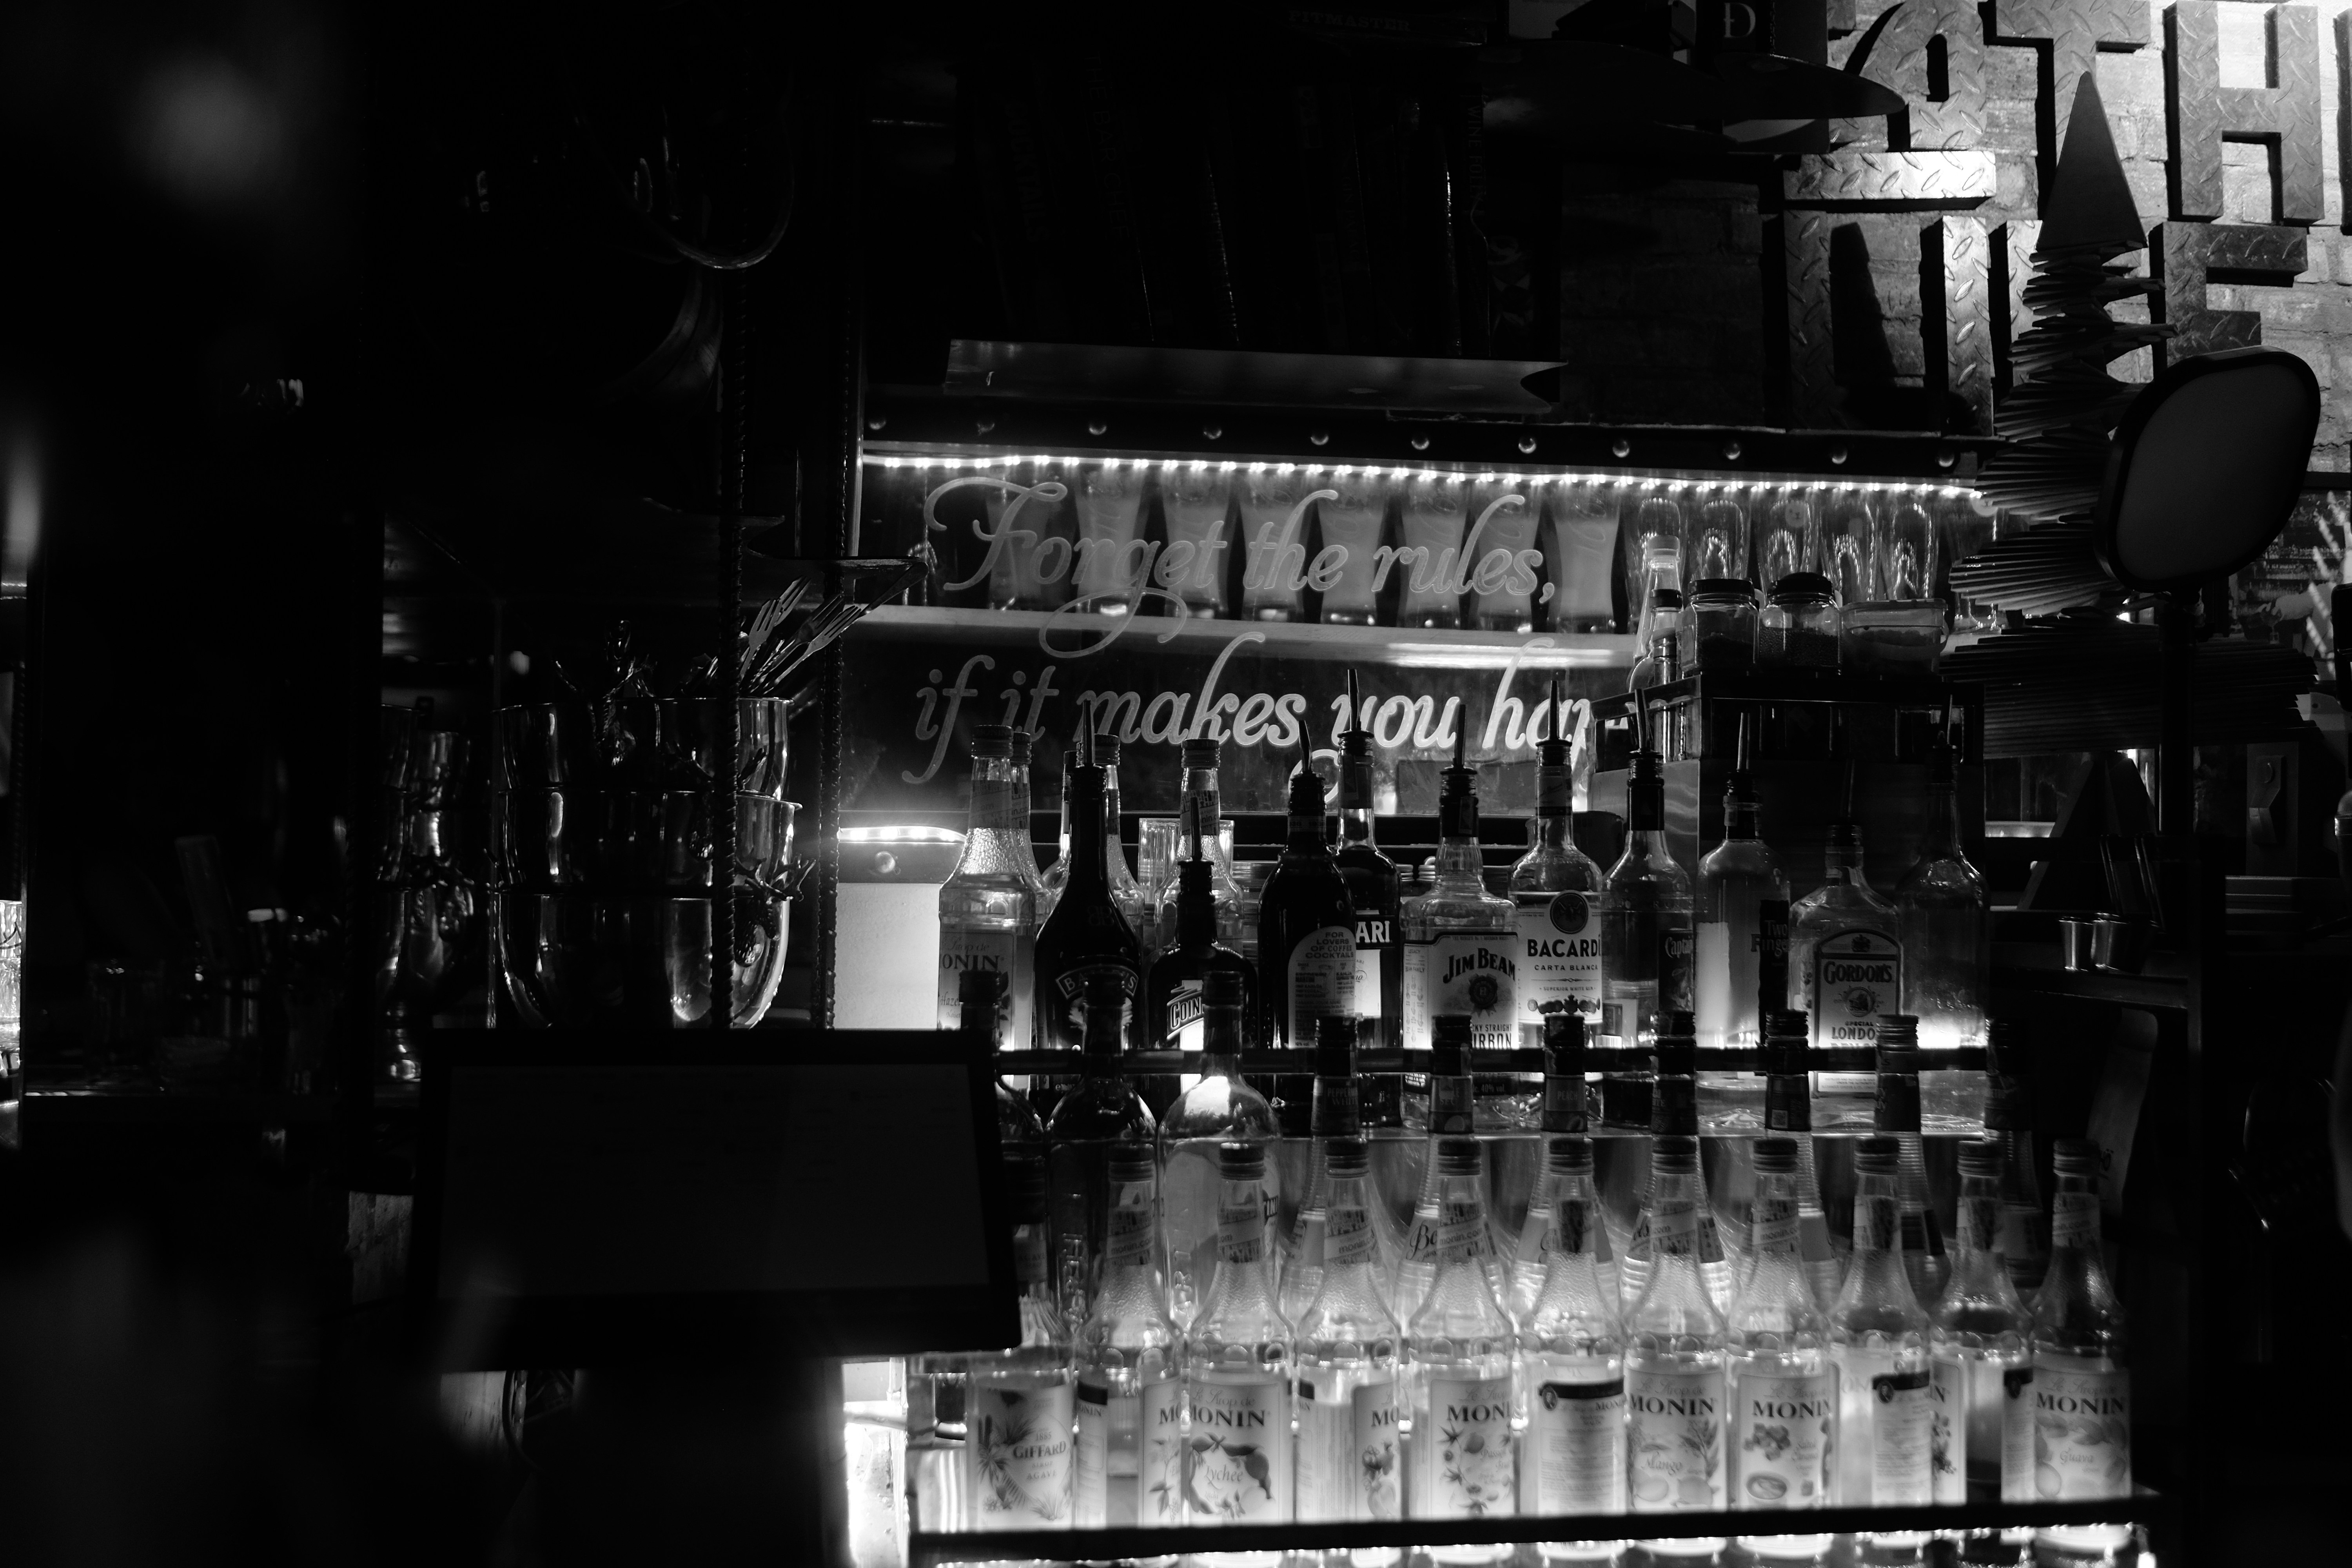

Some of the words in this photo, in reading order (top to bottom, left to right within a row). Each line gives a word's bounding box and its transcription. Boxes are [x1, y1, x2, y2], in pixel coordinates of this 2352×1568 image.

[924, 476, 1228, 659] Forget
[1243, 489, 1349, 590] the
[1373, 494, 1555, 604] rules,
[902, 654, 996, 784] if
[1000, 665, 1060, 742] it
[1073, 632, 1307, 748] makes
[1356, 921, 1390, 944] ARI
[1764, 920, 1788, 937] Two
[940, 953, 1000, 971] ONIN
[1443, 954, 1475, 984] JIM
[1477, 947, 1515, 982] BEAM
[940, 991, 961, 1006] Haze
[1169, 996, 1203, 1030] COIN
[1831, 1026, 1876, 1040] LONDO
[1446, 1401, 1511, 1422] MONI
[1630, 1393, 1716, 1416] MONIN
[2036, 1391, 2127, 1415] MONIN
[1036, 1432, 1052, 1441] 1885
[1013, 1441, 1067, 1459] GIFFARD
